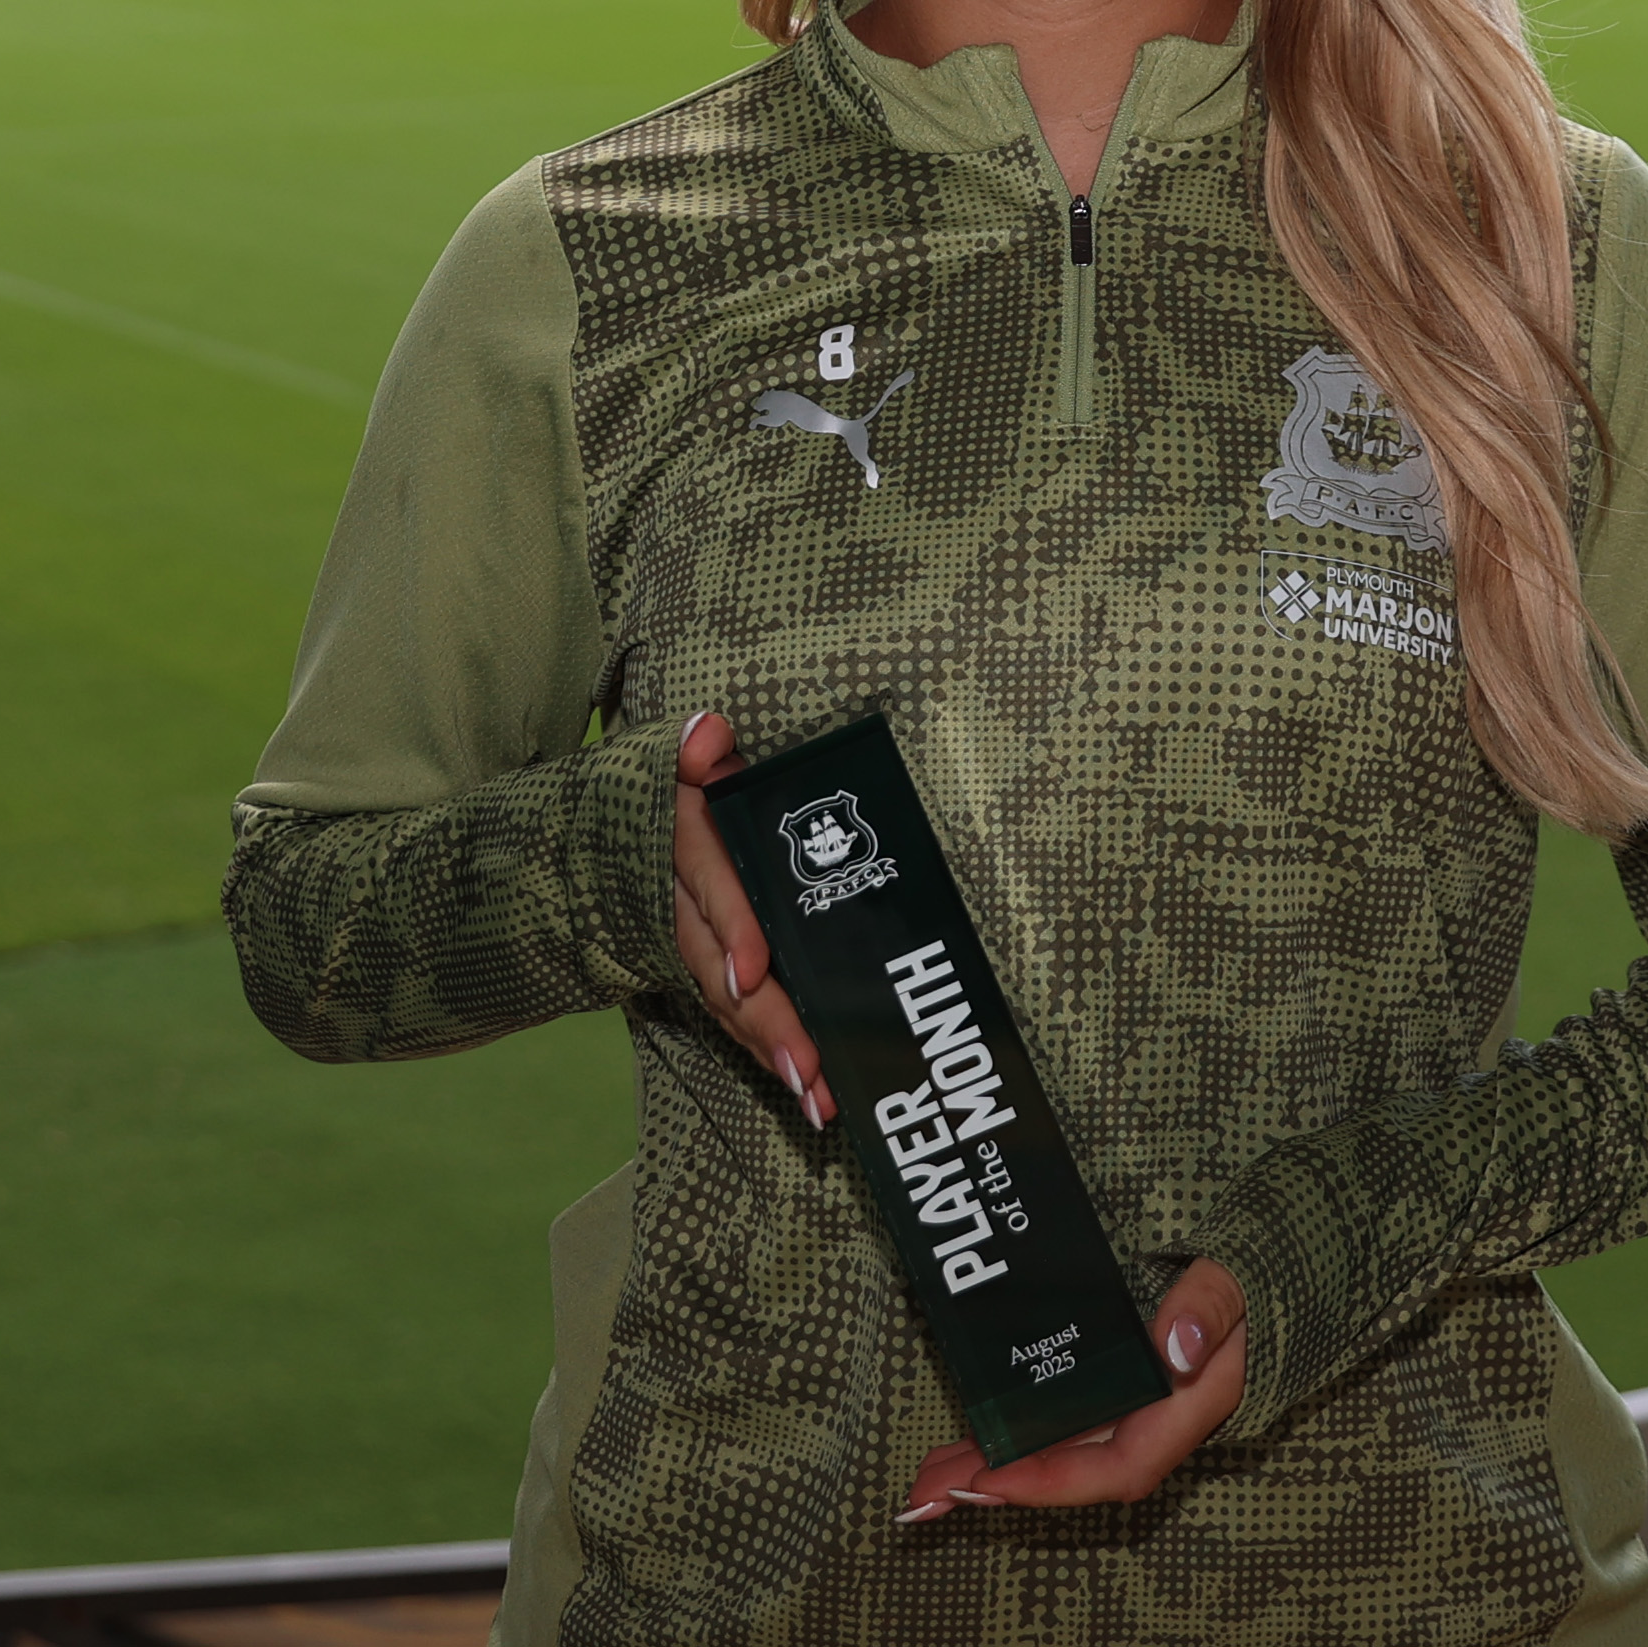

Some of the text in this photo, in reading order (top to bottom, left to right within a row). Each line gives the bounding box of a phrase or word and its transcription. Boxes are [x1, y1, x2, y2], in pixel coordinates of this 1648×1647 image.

[818, 323, 855, 381] 8
[1326, 566, 1415, 600] PLYMOUTH
[1325, 586, 1453, 643] MARJON
[1323, 617, 1452, 666] UNIVERSITY
[885, 939, 1030, 1232] of the MONTH
[874, 1079, 1010, 1295] PLAYER
[1011, 1322, 1081, 1366] August
[1030, 1349, 1076, 1384] 2025
